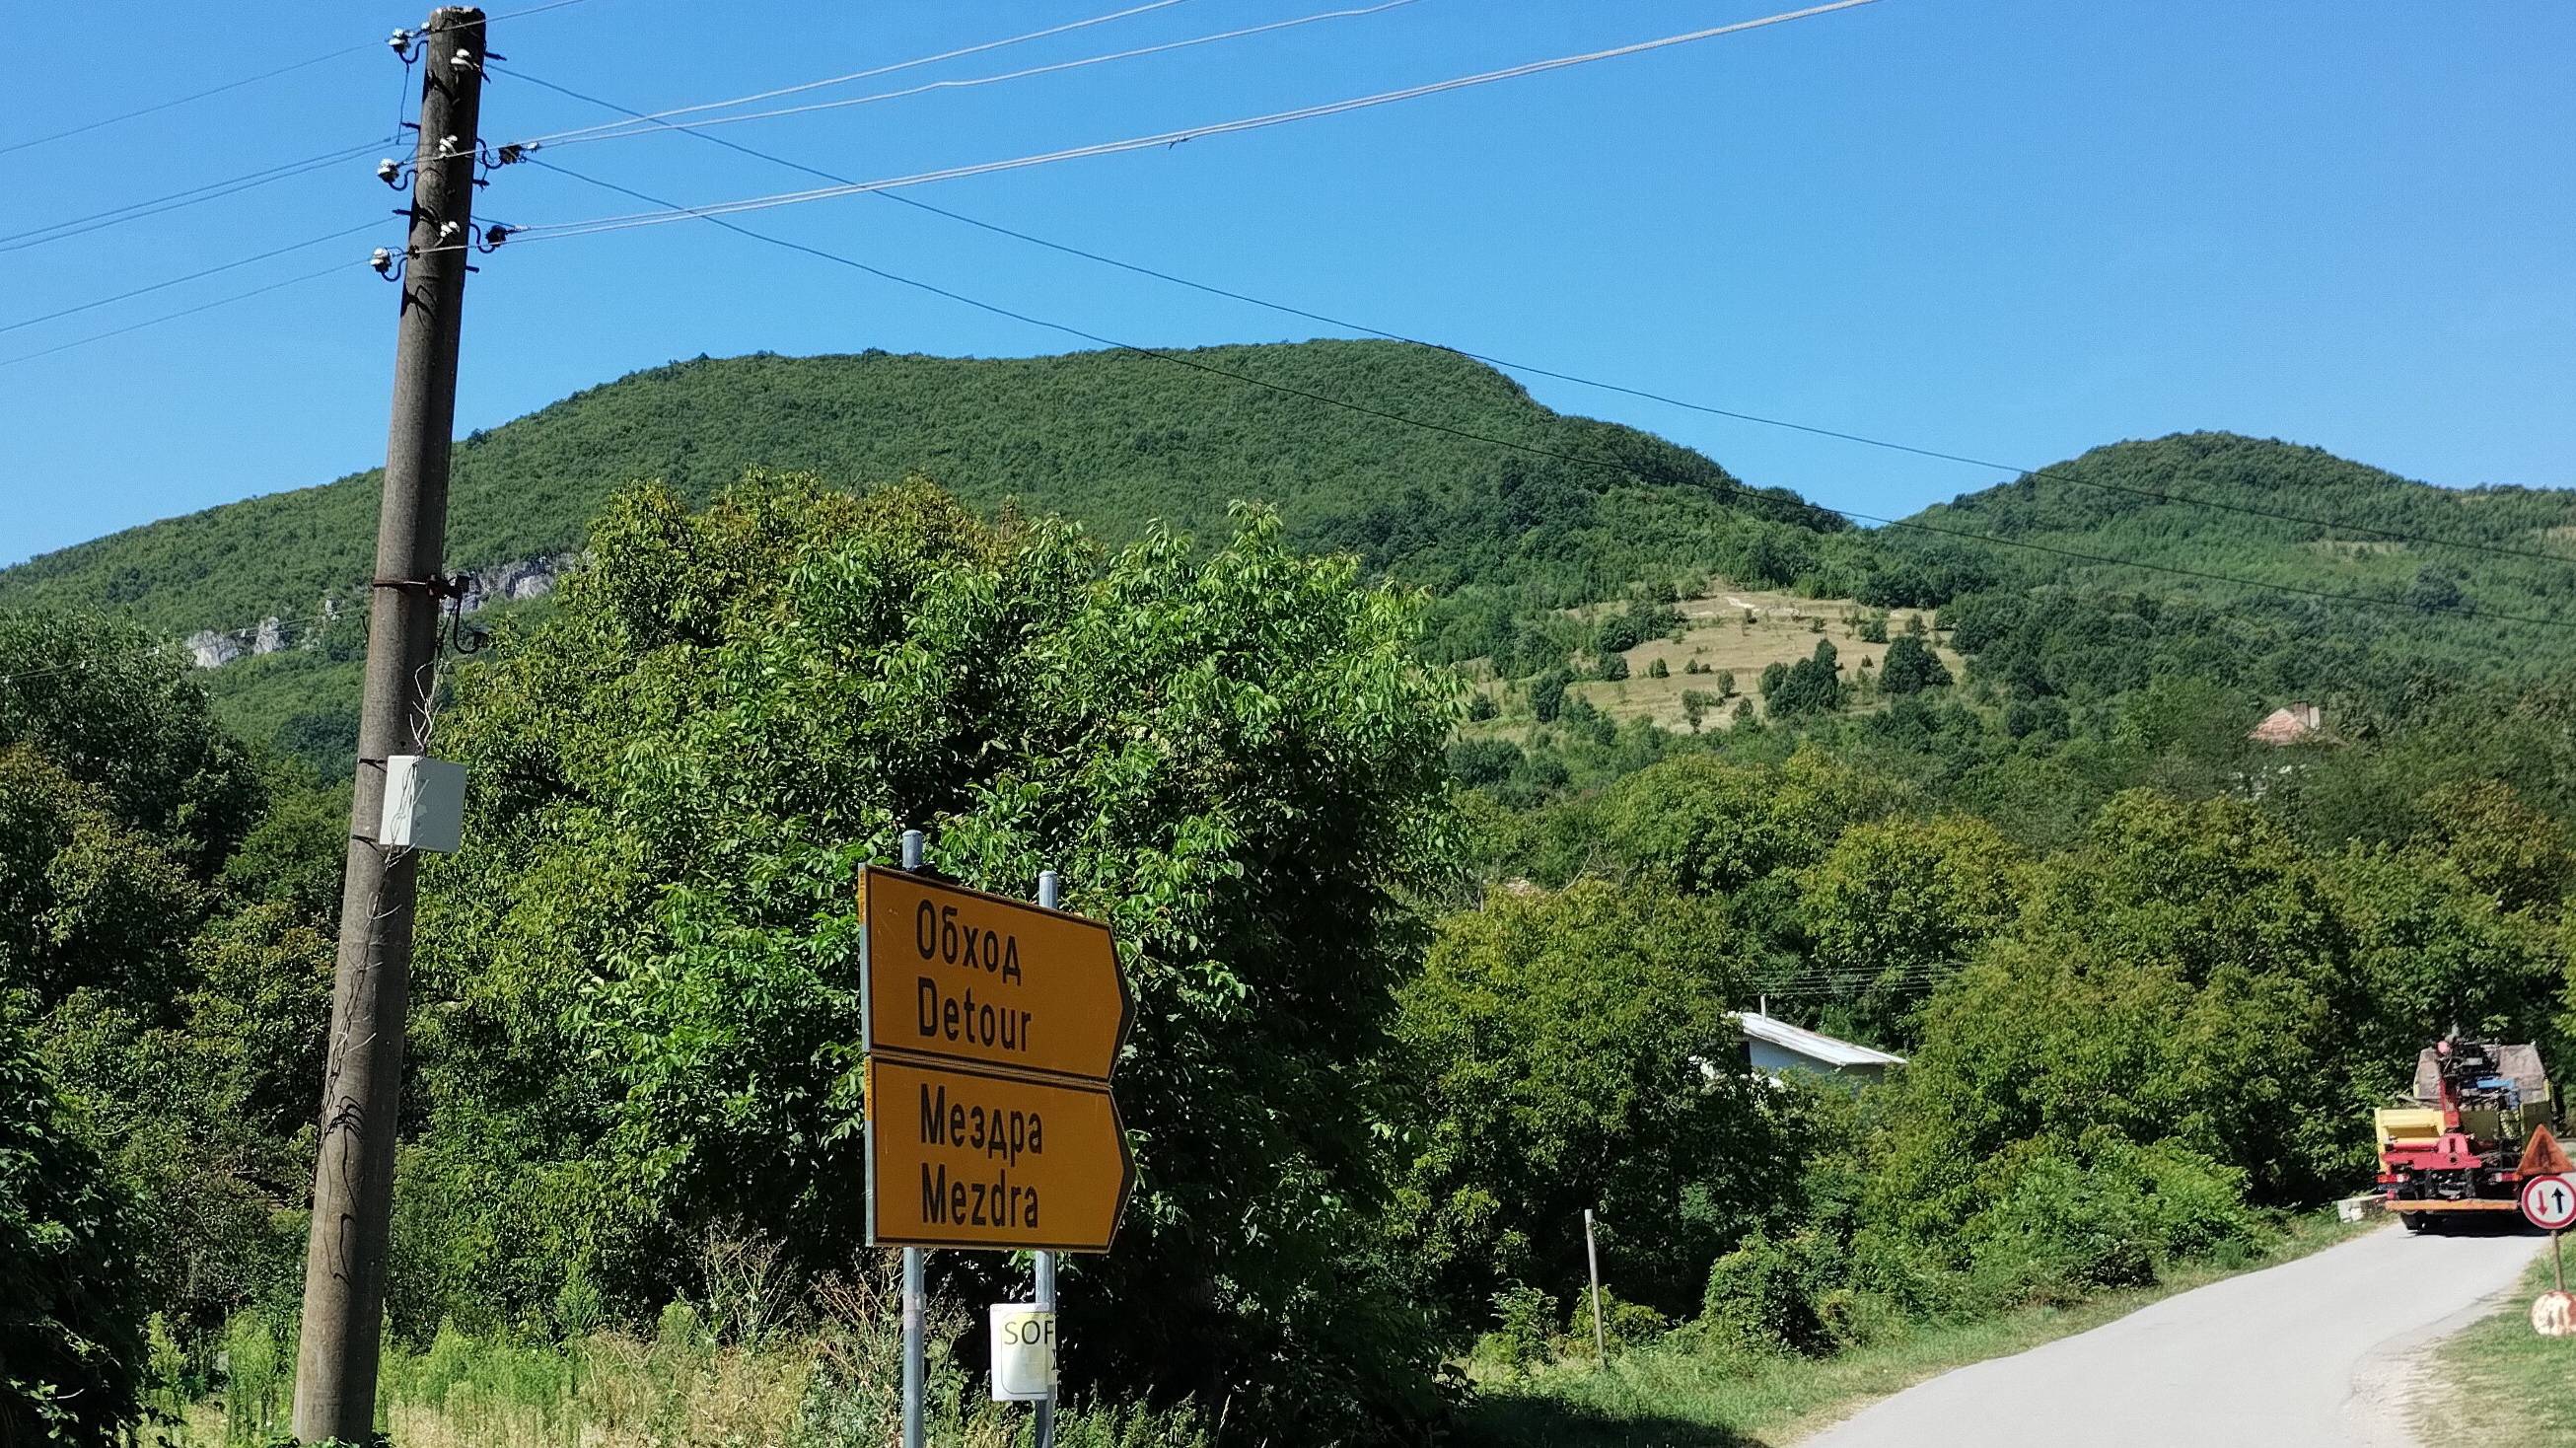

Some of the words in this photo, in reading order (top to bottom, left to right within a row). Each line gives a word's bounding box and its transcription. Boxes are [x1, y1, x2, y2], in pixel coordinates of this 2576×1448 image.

[916, 899, 1022, 986] Обход
[917, 976, 1032, 1052] Detour
[920, 1082, 1042, 1168] Мездра
[921, 1162, 1038, 1229] Mezdra
